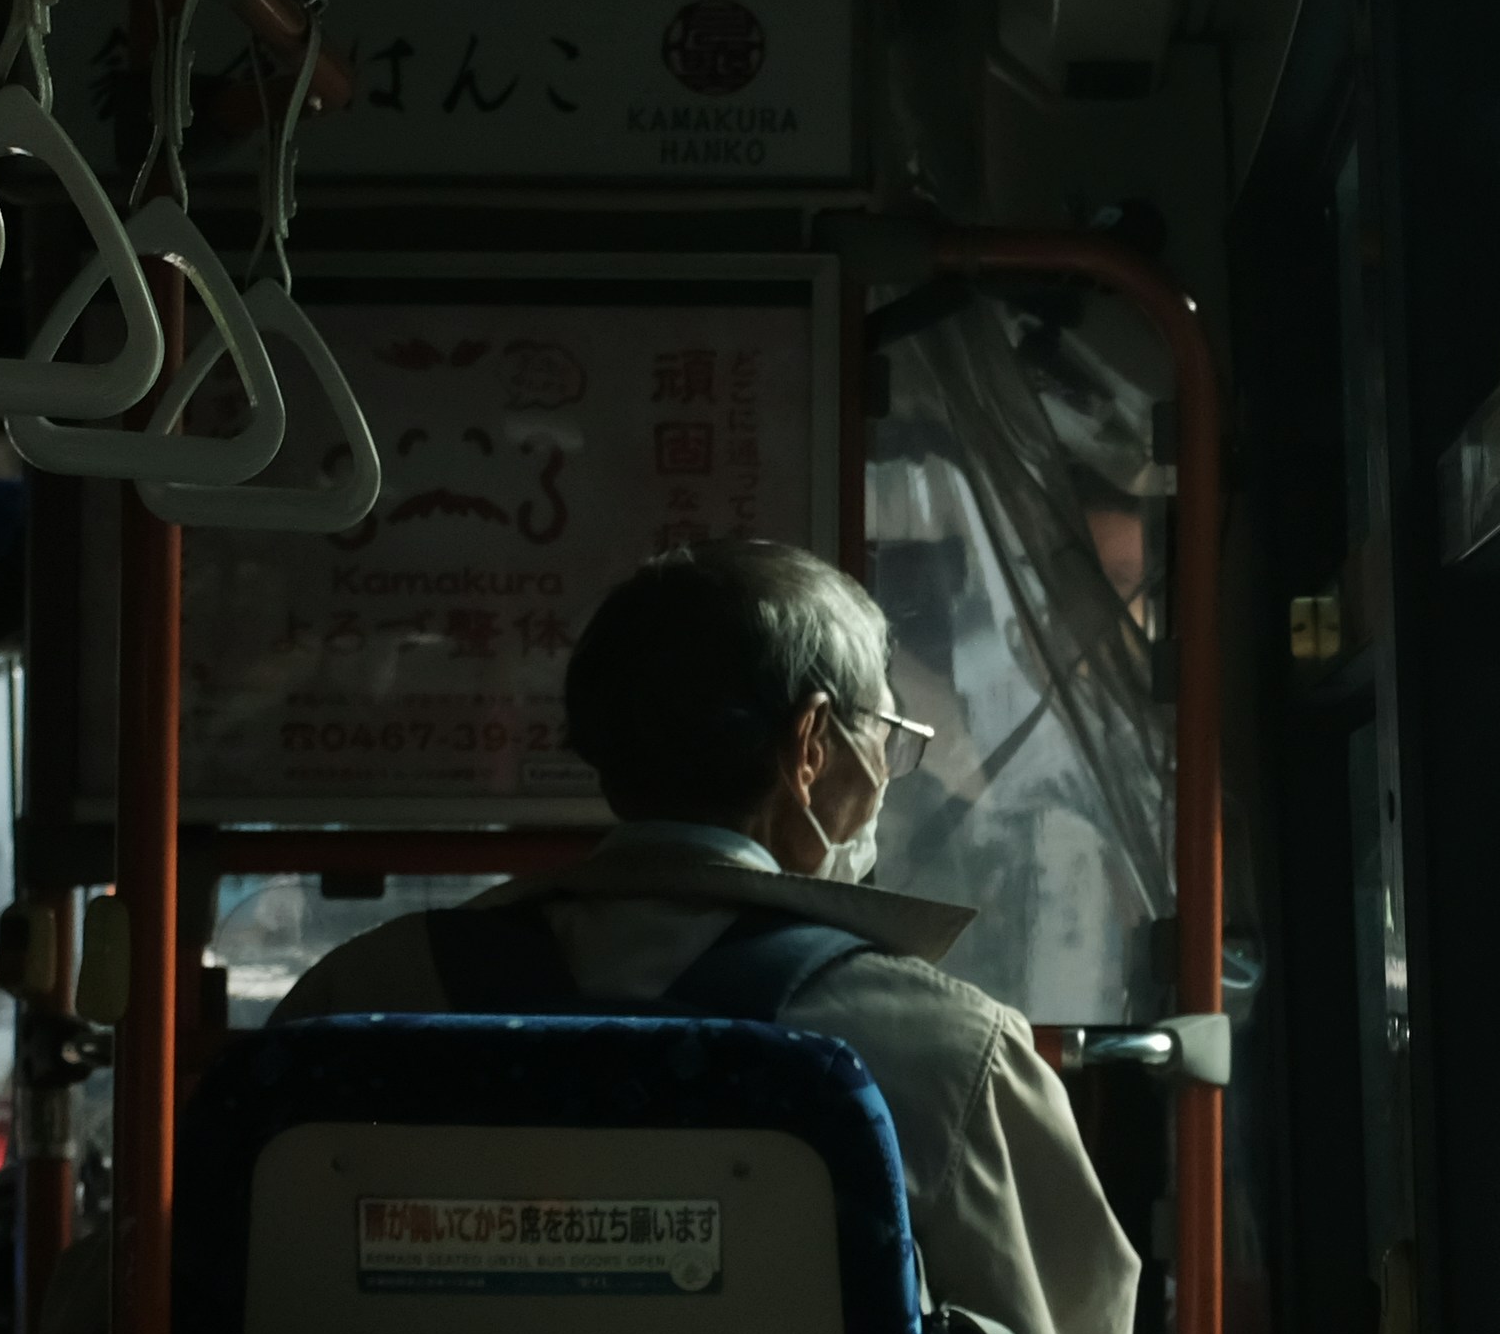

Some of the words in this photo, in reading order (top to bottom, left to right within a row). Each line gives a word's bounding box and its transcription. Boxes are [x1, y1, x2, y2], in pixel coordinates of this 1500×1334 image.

[627, 107, 798, 133] KAMAKURA
[660, 139, 767, 166] HANKO
[332, 566, 564, 596] Kamakura
[366, 1252, 422, 1266] REMAIN
[429, 1253, 483, 1267] SEATED
[488, 1253, 530, 1267] UNTIL
[537, 1253, 566, 1267] BUS
[571, 1253, 621, 1267] DOORS
[626, 1253, 666, 1267] OPEN
